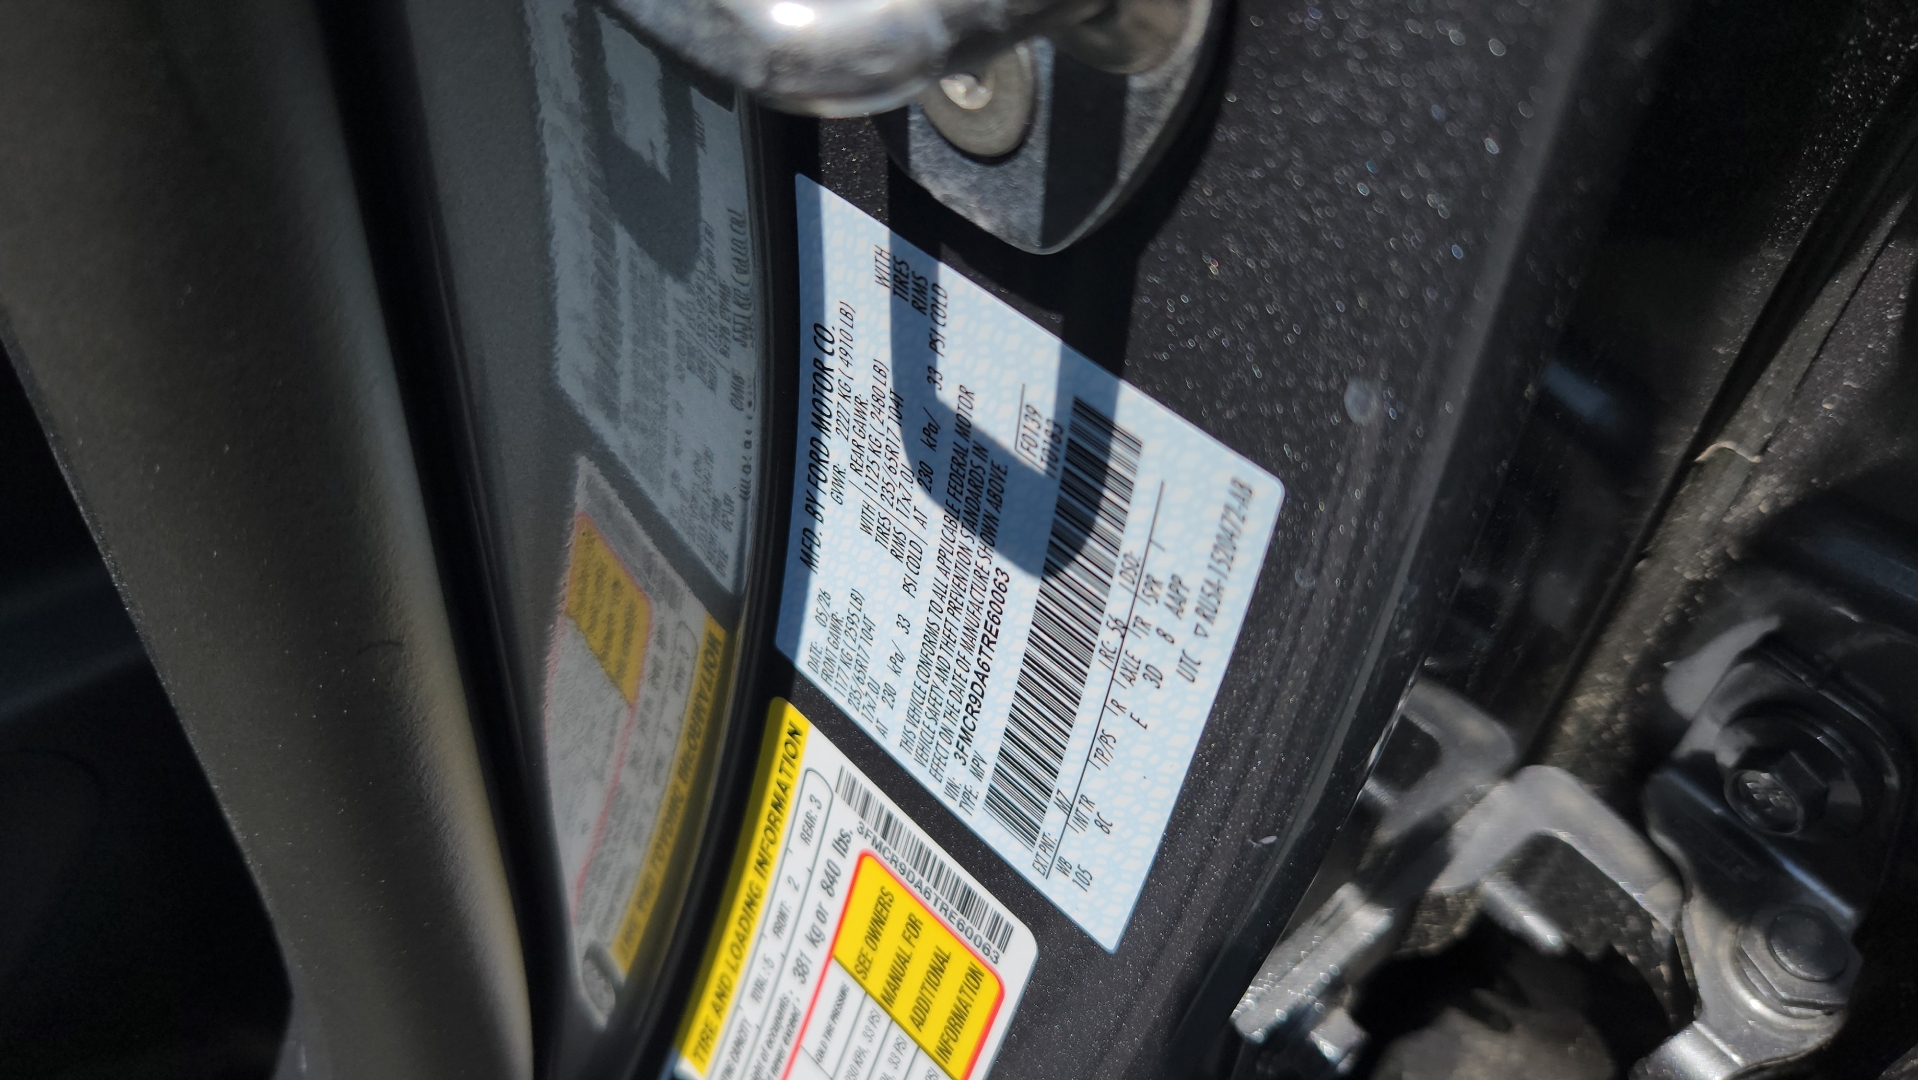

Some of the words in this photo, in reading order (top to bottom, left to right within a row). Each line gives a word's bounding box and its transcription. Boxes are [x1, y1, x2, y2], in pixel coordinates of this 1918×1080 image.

[874, 245, 890, 289] WITH
[892, 255, 909, 303] TIRES
[911, 270, 928, 316] RIMS
[930, 283, 948, 328] COLD
[839, 301, 855, 330] LB)
[814, 323, 835, 357] CO.
[838, 328, 853, 368] 4910
[929, 327, 946, 358] PSI
[837, 378, 851, 404] KG
[872, 358, 889, 387] LB)
[927, 366, 943, 391] 33
[812, 358, 834, 440] MOTOR
[852, 394, 869, 440] GAWR:
[870, 385, 886, 426] 2480
[887, 387, 904, 427] 104T
[955, 384, 975, 442] MOTOR
[835, 401, 850, 442] 2227
[920, 407, 940, 452] kPa/
[1020, 404, 1042, 458] F0139
[849, 438, 865, 477] REAR
[867, 434, 882, 459] KG
[971, 440, 989, 464] IN
[808, 437, 830, 496] FORD
[830, 463, 846, 506] GVWR:
[864, 455, 880, 494] 1125
[880, 426, 901, 509] 235/65R17
[917, 460, 934, 494] 230
[946, 441, 969, 504] FEDERAL
[895, 463, 915, 520] 17x7.0J
[959, 459, 986, 545] STANDARDS
[985, 459, 1008, 514] ABOVE.
[805, 490, 825, 525] BY
[859, 499, 876, 536] WITH
[912, 505, 928, 530] AT
[874, 511, 892, 550] TIRES
[890, 526, 907, 564] RIMS
[936, 499, 960, 580] APPLICABLE
[976, 509, 999, 565] SHOWN
[800, 527, 822, 575] MFD.
[905, 539, 923, 576] COLD
[1118, 551, 1141, 587] DSO:
[902, 573, 918, 599] PSI
[932, 577, 948, 604] ALL
[946, 540, 973, 622] PREVENTION
[1142, 573, 1163, 604] SPR
[1163, 573, 1189, 620] AAPP
[814, 588, 831, 628] 05/26
[849, 588, 864, 613] LB)
[928, 599, 944, 621] TO
[959, 560, 990, 657] MANUFACTURE
[827, 611, 844, 650] GAWR:
[844, 608, 860, 644] 2595
[896, 613, 911, 635] 33
[939, 616, 959, 658] THEFT
[1105, 614, 1126, 638] 56
[1132, 615, 1151, 636] TR
[1155, 627, 1175, 644] 8
[806, 641, 823, 675] DATE:
[820, 646, 837, 687] FRONT
[839, 648, 853, 670] KG
[847, 643, 870, 713] 235/65R17
[859, 613, 876, 647] 104T
[887, 639, 904, 677] kPa/
[915, 616, 940, 685] CONFORMS
[955, 650, 971, 673] OF
[1098, 640, 1118, 663] RC:
[1119, 649, 1141, 687] AXLE
[1176, 648, 1201, 683] UTC
[833, 665, 849, 698] 1177
[934, 655, 951, 687] AND
[943, 777, 962, 802] VIN:
[953, 567, 1010, 766] 3FMCR9DA6TRE60063
[948, 668, 968, 705] DATE
[1142, 663, 1163, 690] 3D
[861, 675, 880, 724] 17x7.0J
[881, 682, 897, 710] 230
[905, 680, 927, 729] VEHICLE
[924, 679, 945, 726] SAFETY
[943, 699, 961, 727] THE
[1110, 698, 1127, 714] R
[875, 717, 889, 739] AT
[899, 724, 916, 755] THIS
[938, 722, 955, 746] ON
[1129, 712, 1148, 730] E
[913, 720, 936, 768] VEHICLE
[928, 740, 950, 784] EFFECT
[1093, 728, 1117, 767] TP/PS
[958, 784, 979, 816] TYPE:
[969, 750, 987, 782] MPV
[800, 809, 818, 846] REAR:
[809, 794, 822, 810] 3
[1072, 806, 1089, 832] INT
[1078, 793, 1095, 813] TR
[1093, 811, 1113, 835] 8C
[832, 828, 853, 859] lbs.
[1038, 831, 1057, 858] PNT:
[820, 858, 841, 898] 840
[1032, 851, 1049, 877] EXT
[1055, 855, 1073, 877] WB
[1072, 863, 1093, 892] 105
[692, 1015, 715, 1064] TIRE
[711, 974, 731, 1020] AND
[726, 881, 762, 974] LOADING
[754, 720, 803, 880] INFORMATION
[772, 900, 791, 939] FRONT:
[787, 875, 800, 892] 2
[857, 821, 1000, 965] 3FMCR9DA6TRE60063
[815, 901, 829, 925] or
[805, 922, 825, 949] kg
[854, 947, 874, 981] SEE
[864, 886, 894, 952] OWNERS
[762, 953, 775, 969] 5
[792, 949, 812, 985] 381
[880, 945, 913, 1008] MANUAL
[901, 912, 923, 949] FOR
[909, 945, 951, 1033] ADDITIONAL
[760, 1045, 770, 1063] of
[765, 993, 790, 1050] occupants
[815, 1040, 828, 1063] COLD
[822, 1020, 835, 1042] TIRE
[830, 984, 849, 1025] PRESSURE
[867, 1007, 881, 1029] PSI
[934, 961, 985, 1064] INFORMATION
[729, 1017, 751, 1064] CAPACITY
[770, 1043, 786, 1077] never
[782, 1004, 801, 1046] exceed
[862, 1024, 875, 1043] 33
[893, 1034, 908, 1056] PSI
[852, 1045, 870, 1068] KPA,
[887, 1051, 901, 1070] 33
